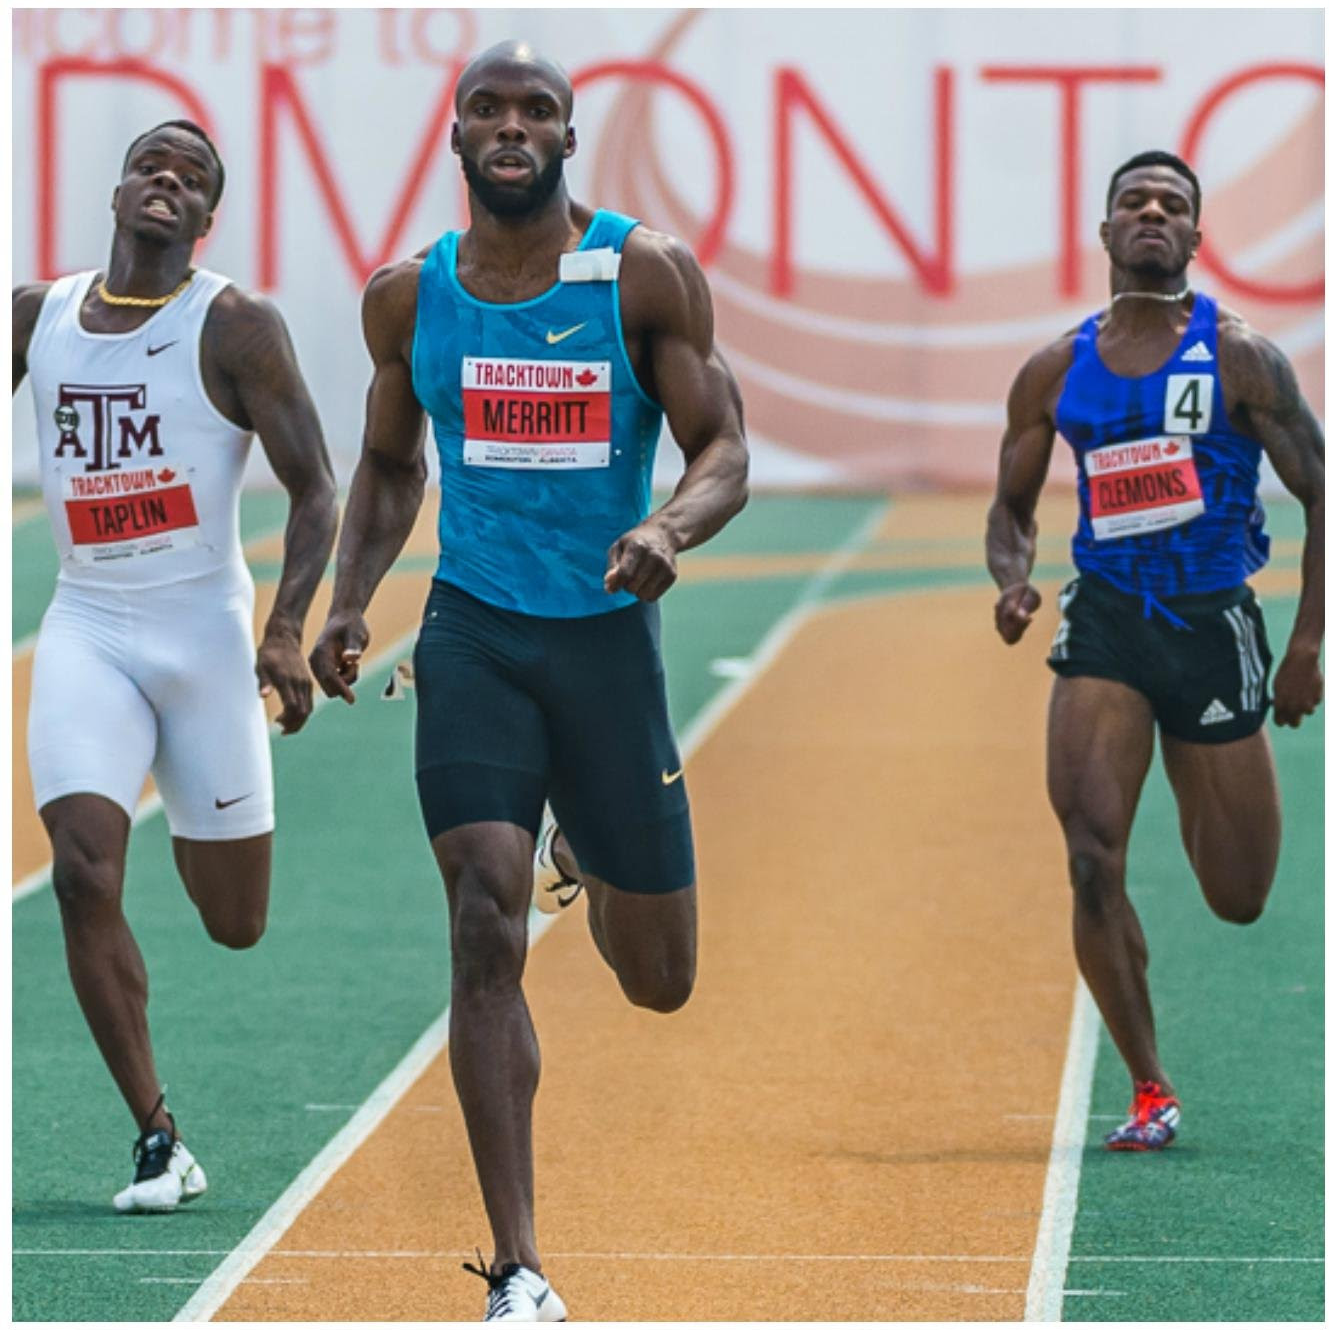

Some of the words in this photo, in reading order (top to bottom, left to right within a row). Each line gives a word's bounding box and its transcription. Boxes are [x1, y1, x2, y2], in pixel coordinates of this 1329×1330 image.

[475, 362, 574, 388] TRACKTOWN
[484, 399, 590, 434] MERRITT
[1174, 380, 1204, 430] 4
[70, 471, 157, 497] TRACKTOWN
[1100, 469, 1188, 509] CLEMONS
[90, 498, 167, 536] TAPLIN
